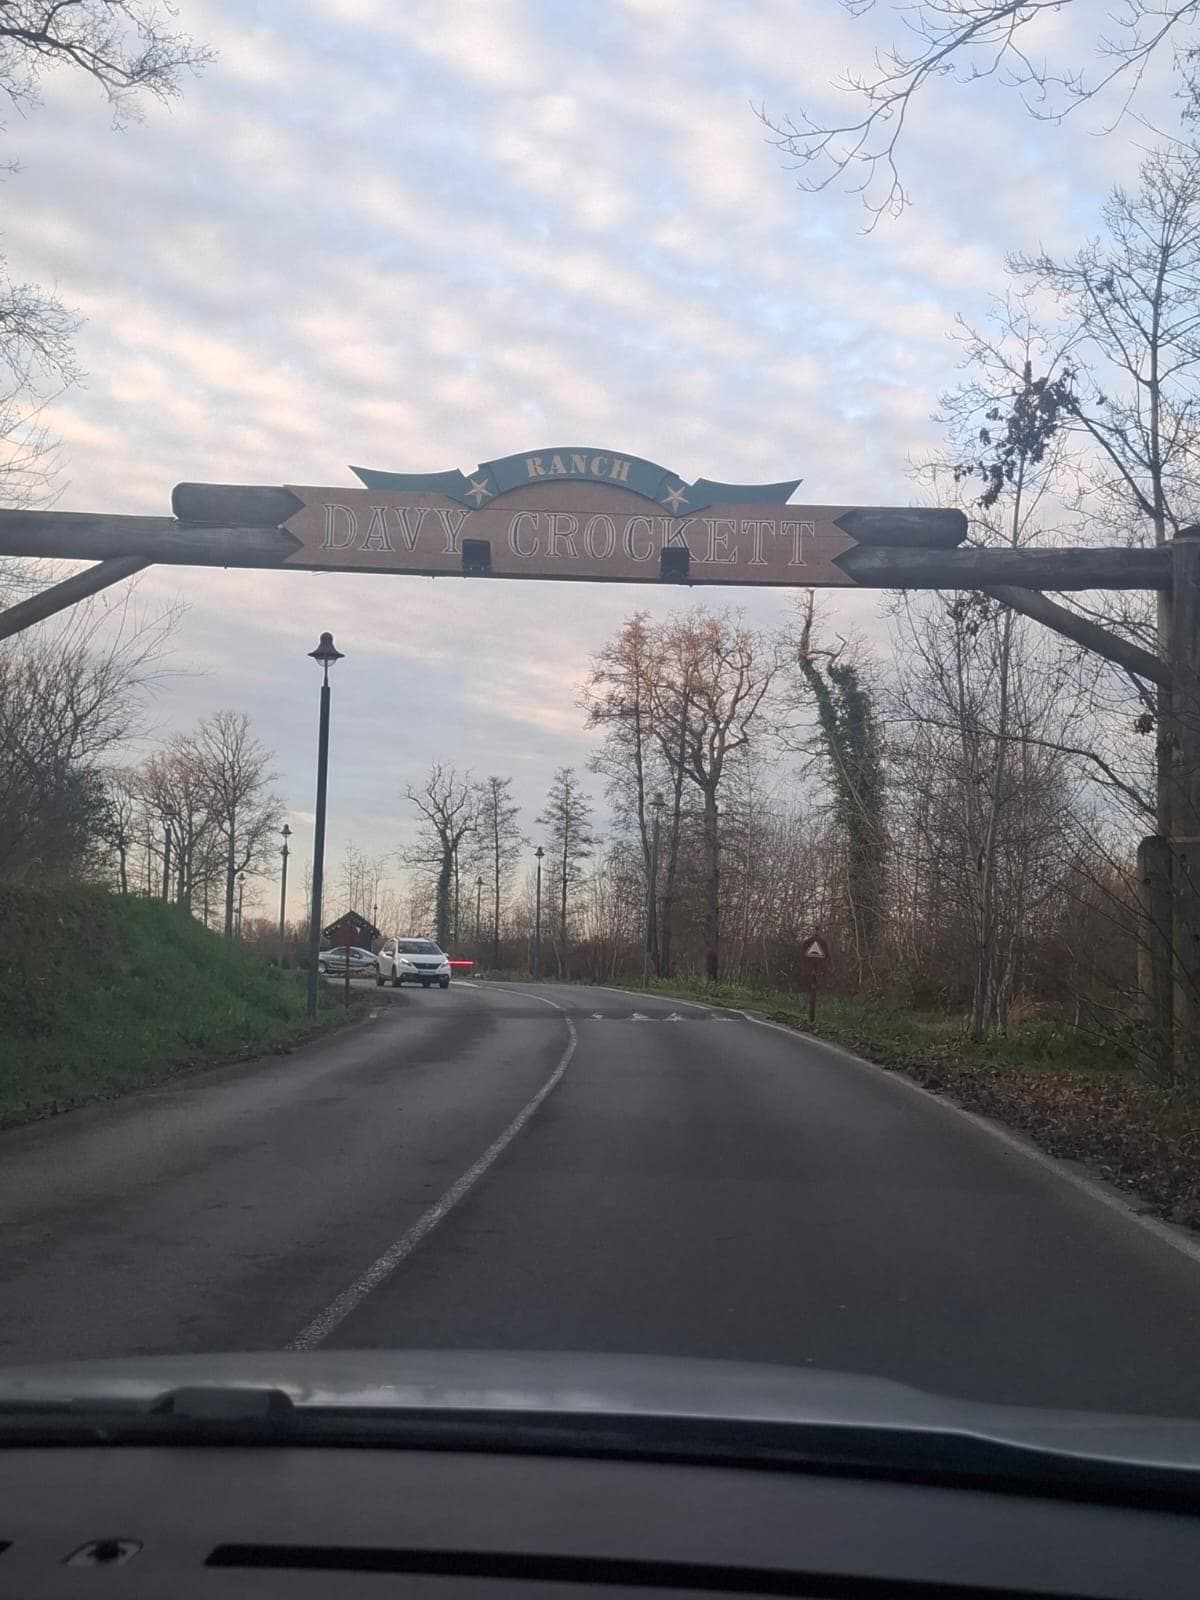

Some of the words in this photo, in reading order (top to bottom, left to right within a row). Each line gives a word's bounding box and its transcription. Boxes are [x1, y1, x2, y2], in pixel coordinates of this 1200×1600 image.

[525, 454, 633, 481] RANCH
[320, 503, 473, 554] DAVY
[508, 511, 816, 566] CROCKETT
